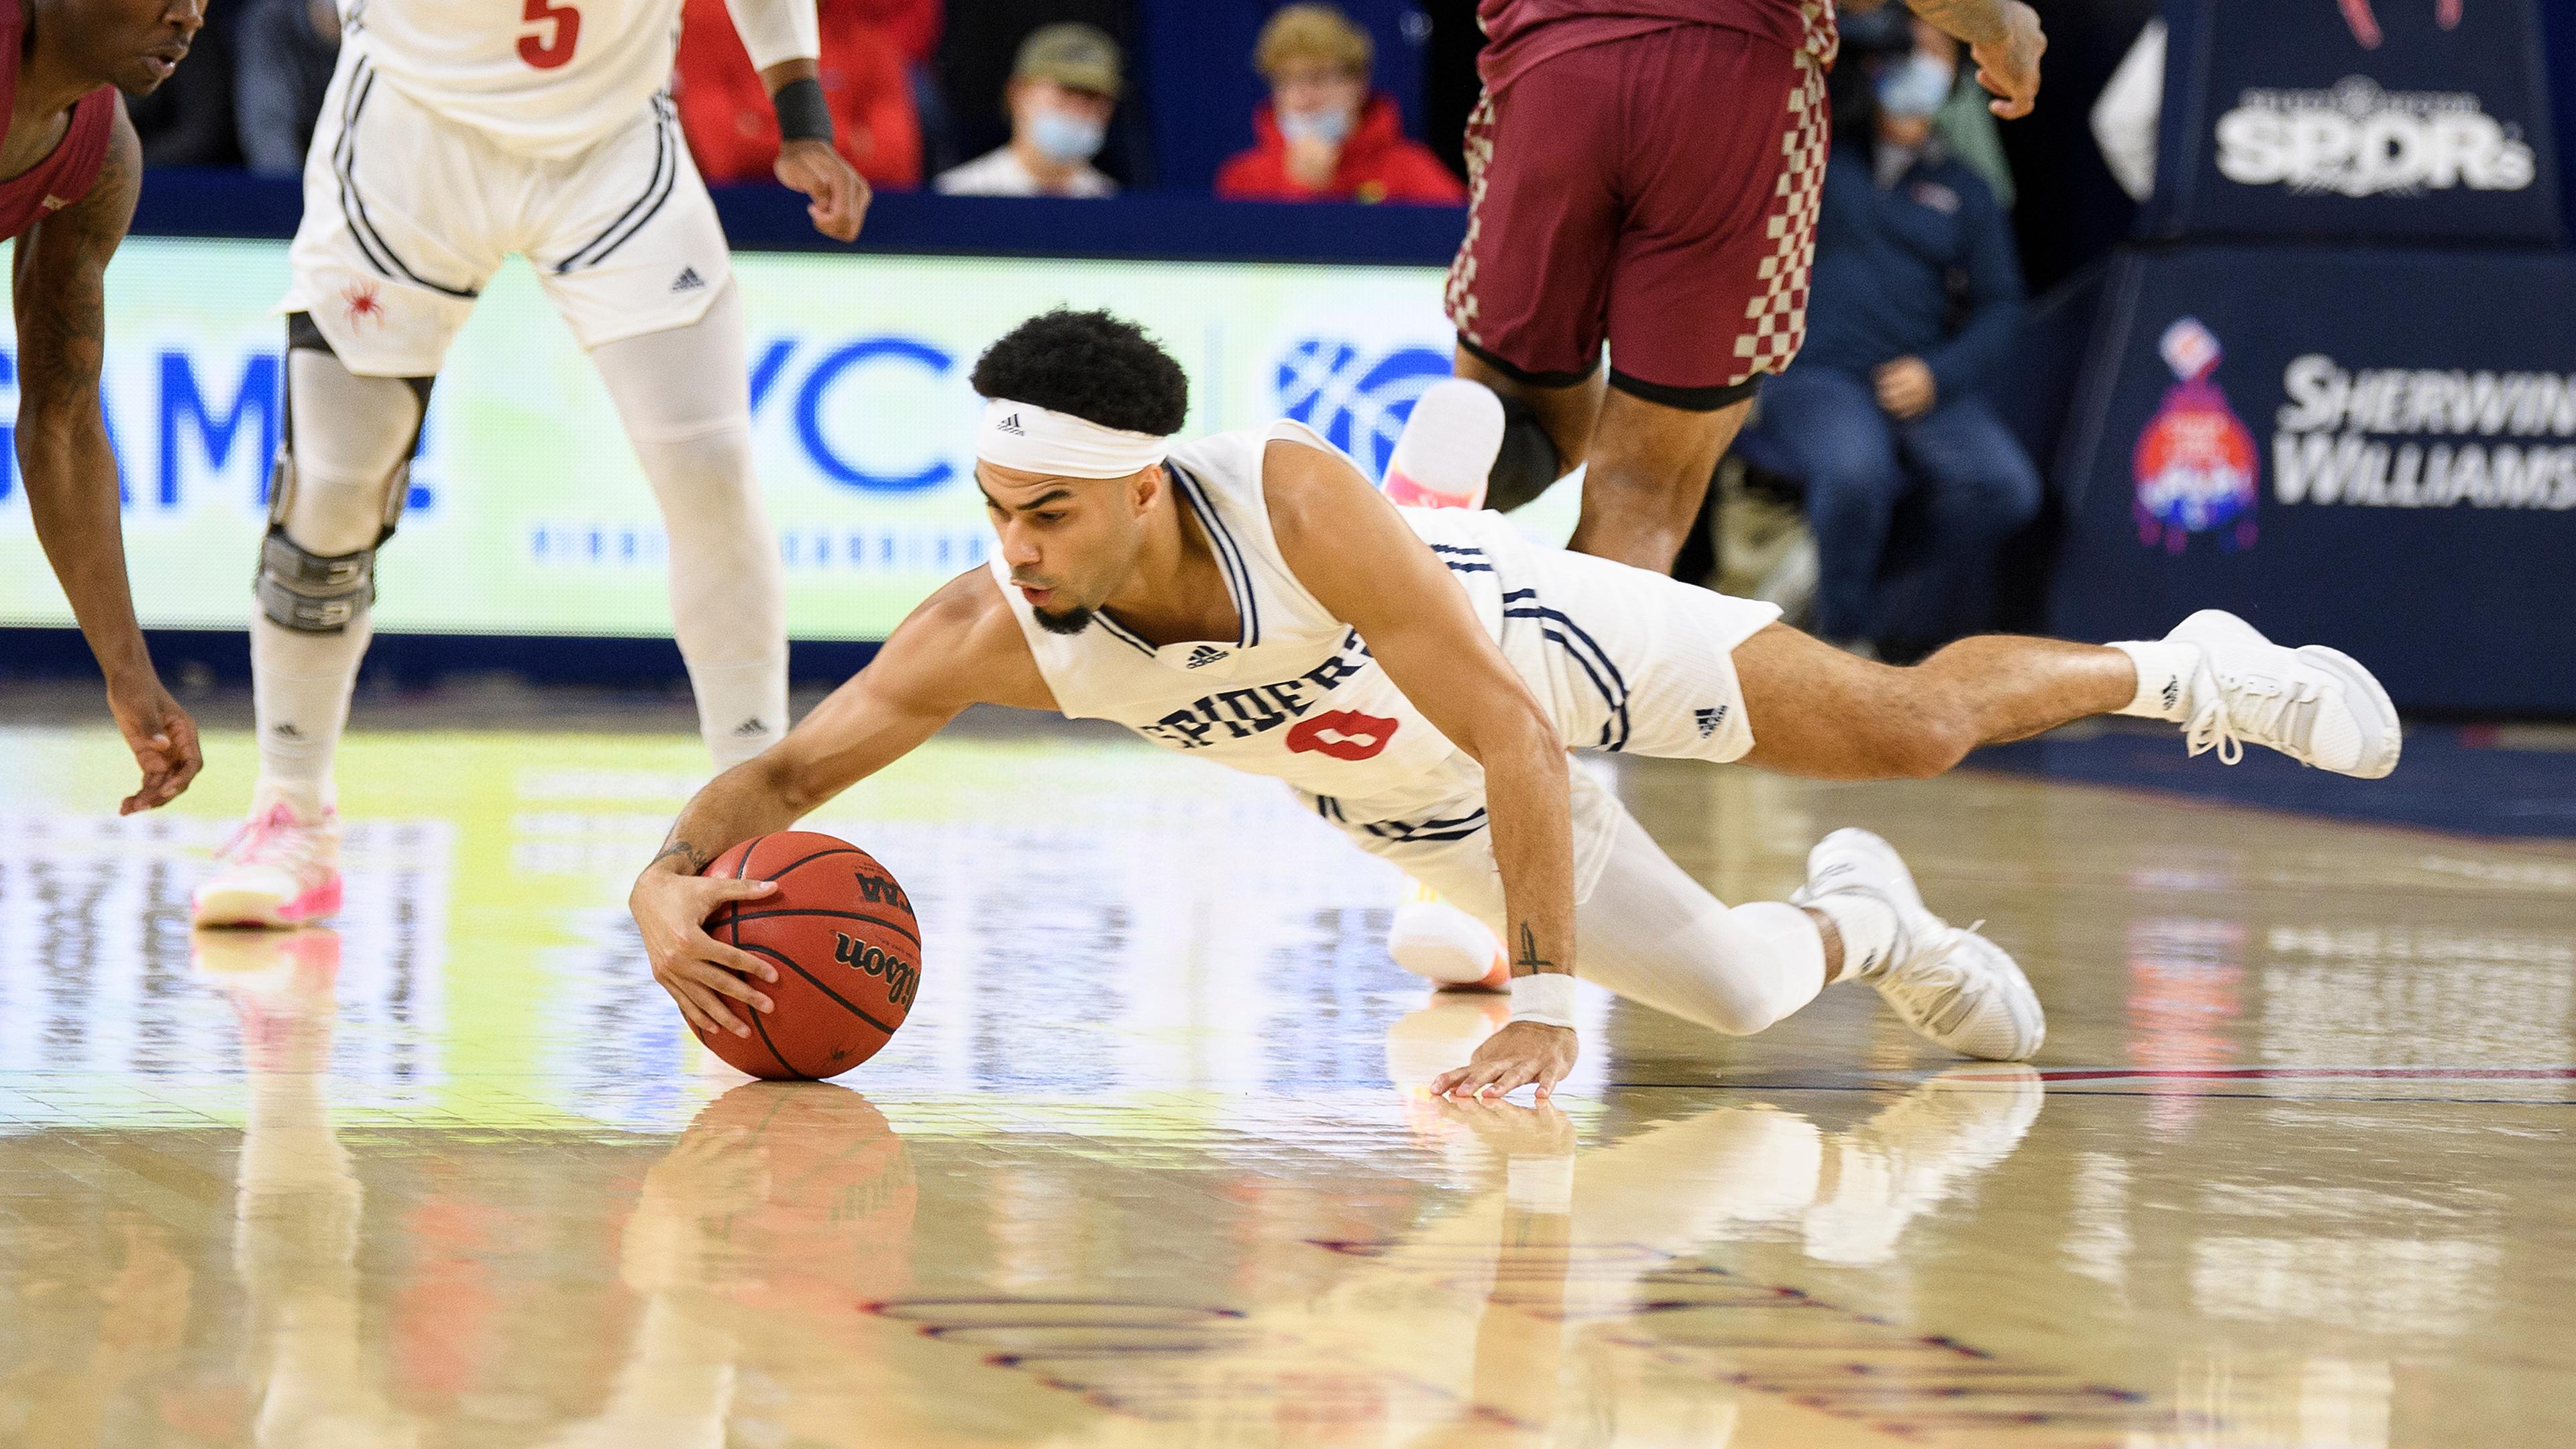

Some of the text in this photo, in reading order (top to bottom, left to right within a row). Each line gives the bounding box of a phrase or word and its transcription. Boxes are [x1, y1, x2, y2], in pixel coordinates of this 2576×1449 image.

[517, 0, 580, 69] 5
[1187, 651, 1230, 669] adidas
[1286, 709, 1399, 761] 0
